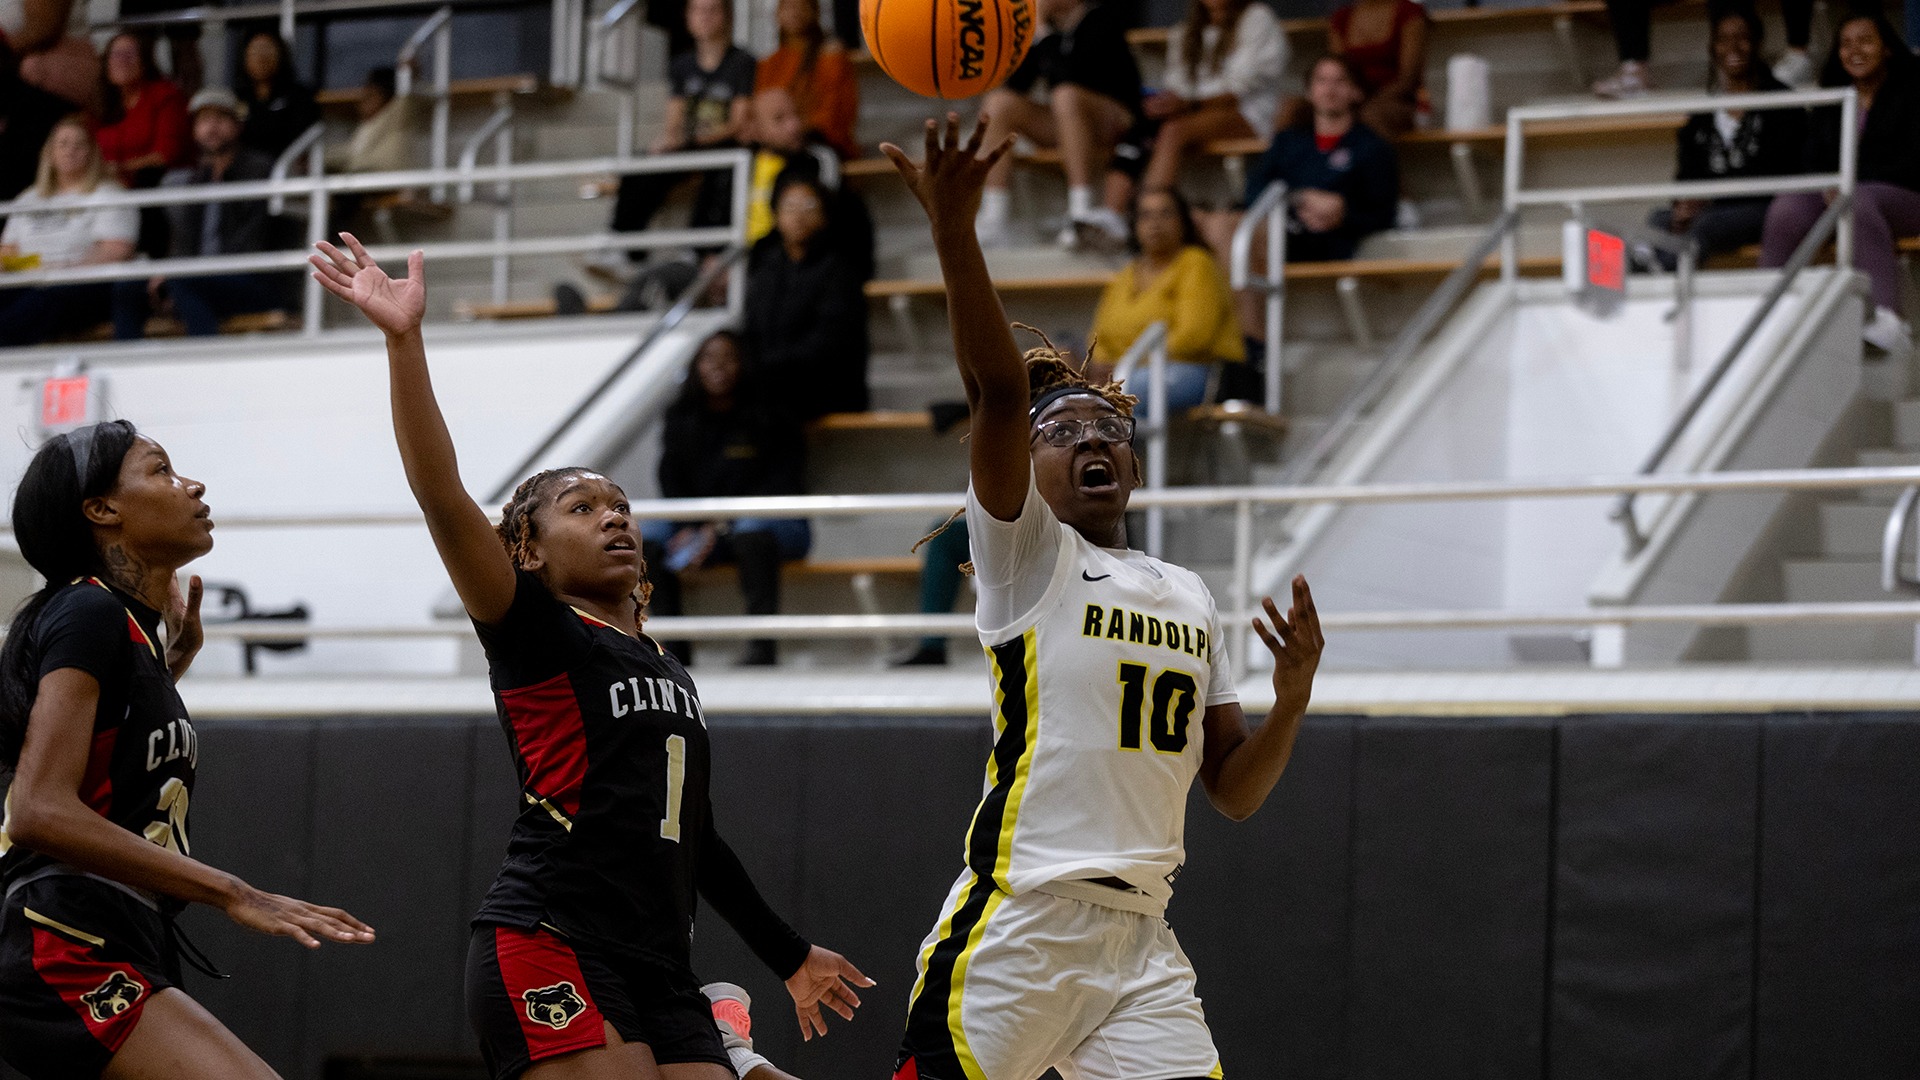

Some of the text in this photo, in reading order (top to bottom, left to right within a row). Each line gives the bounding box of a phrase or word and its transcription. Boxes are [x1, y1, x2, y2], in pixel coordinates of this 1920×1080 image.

[958, 0, 985, 80] NCAA
[1117, 659, 1197, 755] 10
[660, 733, 686, 843] 1
